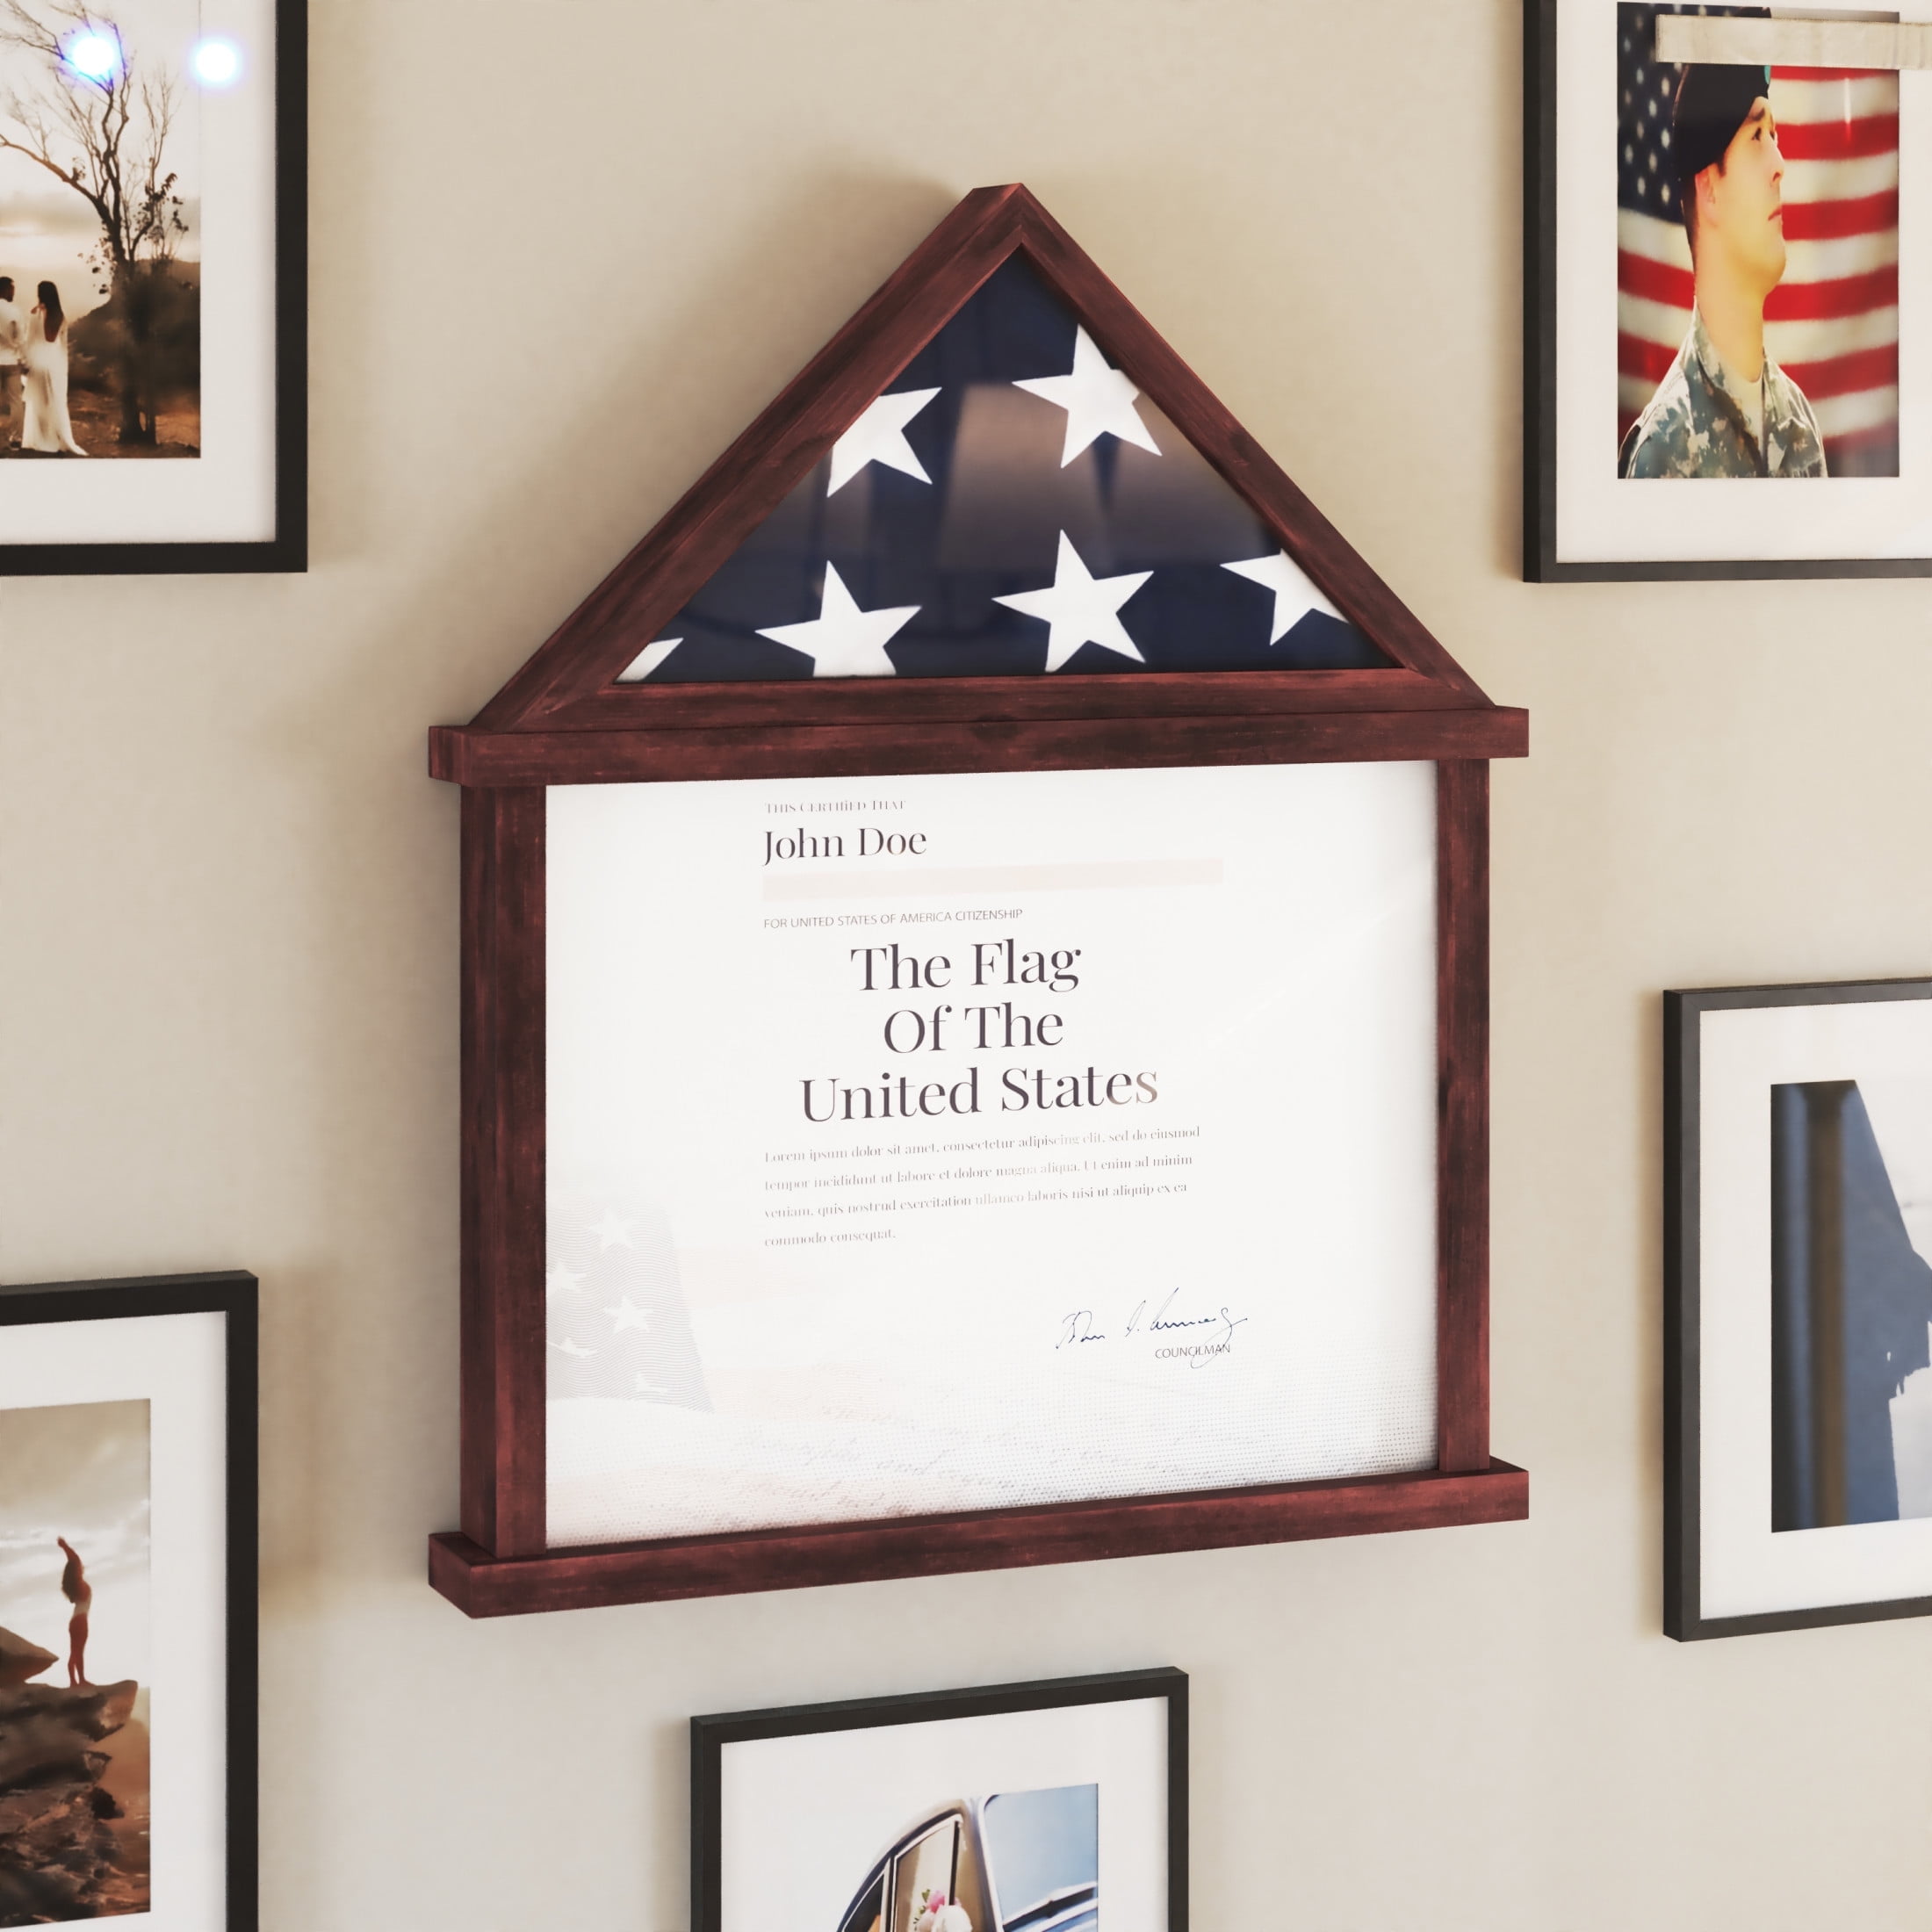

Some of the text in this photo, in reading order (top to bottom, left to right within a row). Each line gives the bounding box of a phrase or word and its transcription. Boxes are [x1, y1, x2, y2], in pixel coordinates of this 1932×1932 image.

[765, 803, 797, 814] THIS
[872, 800, 906, 811] THAT
[761, 827, 927, 867] John Doe
[763, 908, 1023, 929] FOR UNITED STATES OF AMERICA CITIZENSHIP
[850, 937, 1082, 993] The Flag
[883, 1001, 1063, 1054] Of The
[799, 1066, 1158, 1123] United States
[765, 1151, 805, 1164] Lorem
[809, 1149, 847, 1163] ipsum
[851, 1144, 883, 1157] dolor
[887, 1144, 900, 1156] sit
[942, 1138, 1016, 1152] consectetur
[1018, 1134, 1080, 1150] adipiscing
[1108, 1129, 1128, 1143] sed
[1132, 1128, 1147, 1141] do
[1150, 1125, 1200, 1140] eiusmod
[765, 1179, 810, 1193] tempor
[881, 1173, 892, 1184] ut
[898, 1170, 935, 1183] labore
[938, 1169, 950, 1180] et
[954, 1165, 992, 1179] dolore
[1100, 1157, 1131, 1171] enim
[1135, 1156, 1149, 1167] ad
[1153, 1154, 1193, 1167] minim
[818, 1202, 844, 1218] quis
[847, 1199, 897, 1214] nostrud
[899, 1195, 971, 1210] exercitation
[1027, 1188, 1069, 1202] laboris
[1071, 1186, 1093, 1200] nisi
[1097, 1186, 1108, 1198] ut
[1113, 1183, 1155, 1198] aliquip
[1157, 1185, 1171, 1193] ex
[1173, 1183, 1187, 1193] ea
[764, 1229, 897, 1247] commodo consequat.
[1155, 1344, 1230, 1359] COUNCILMAN
